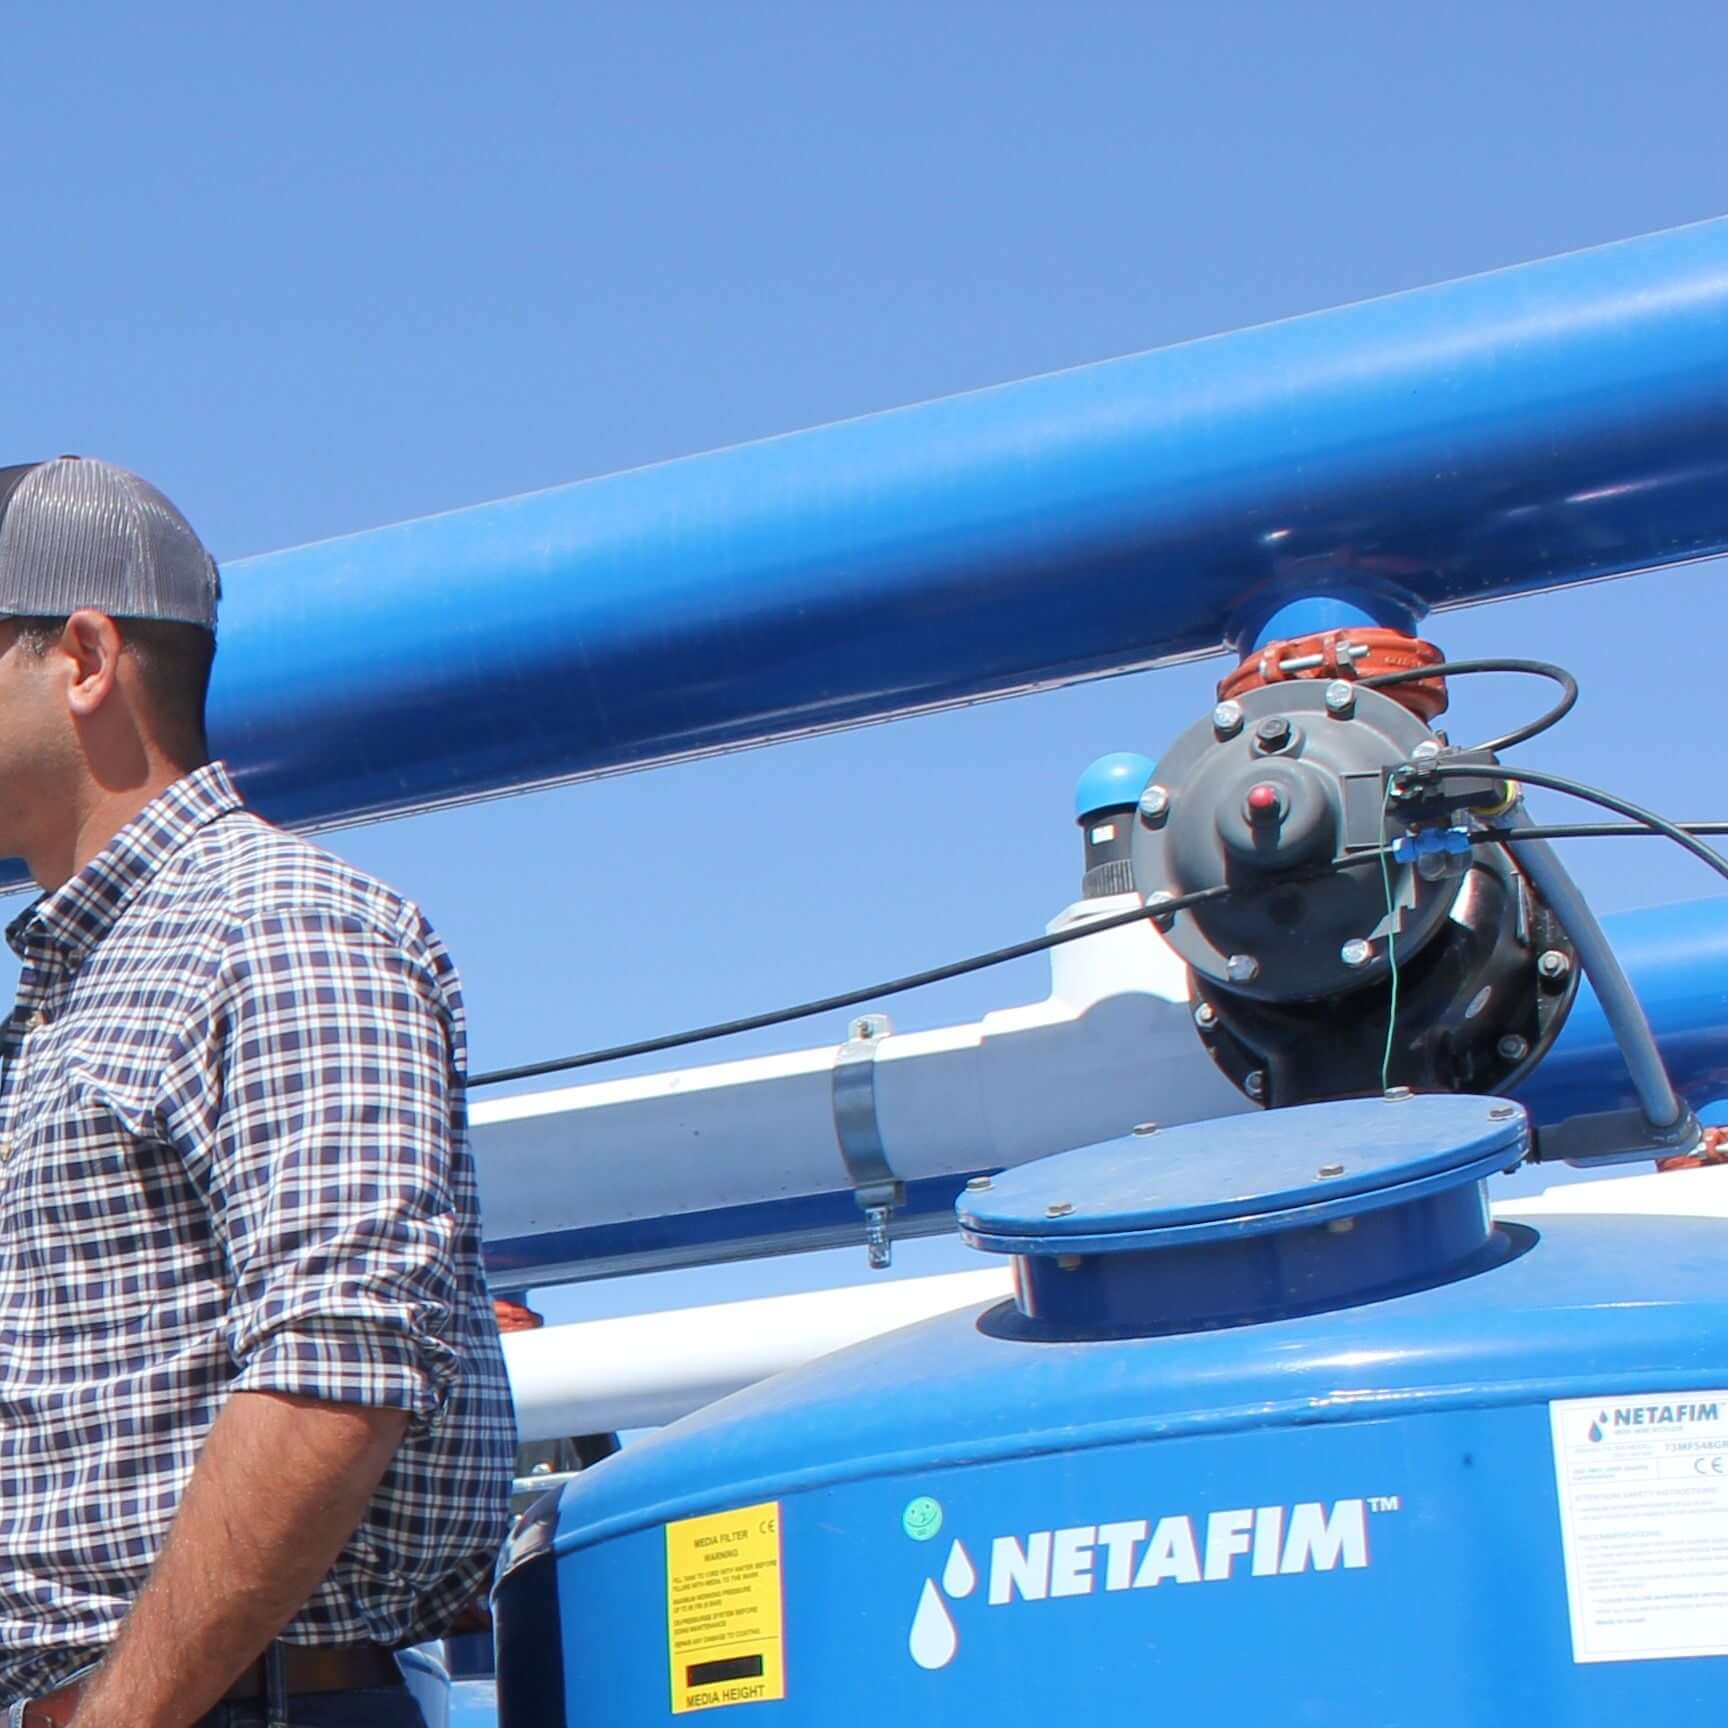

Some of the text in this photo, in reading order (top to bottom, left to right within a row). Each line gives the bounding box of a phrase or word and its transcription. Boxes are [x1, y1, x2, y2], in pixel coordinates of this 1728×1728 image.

[1614, 1403, 1719, 1426] NETAFIM
[693, 1529, 748, 1548] MEDIA FILTER
[988, 1499, 1368, 1605] NETAFIM
[687, 1684, 764, 1707] MEDIA HEIGHT
